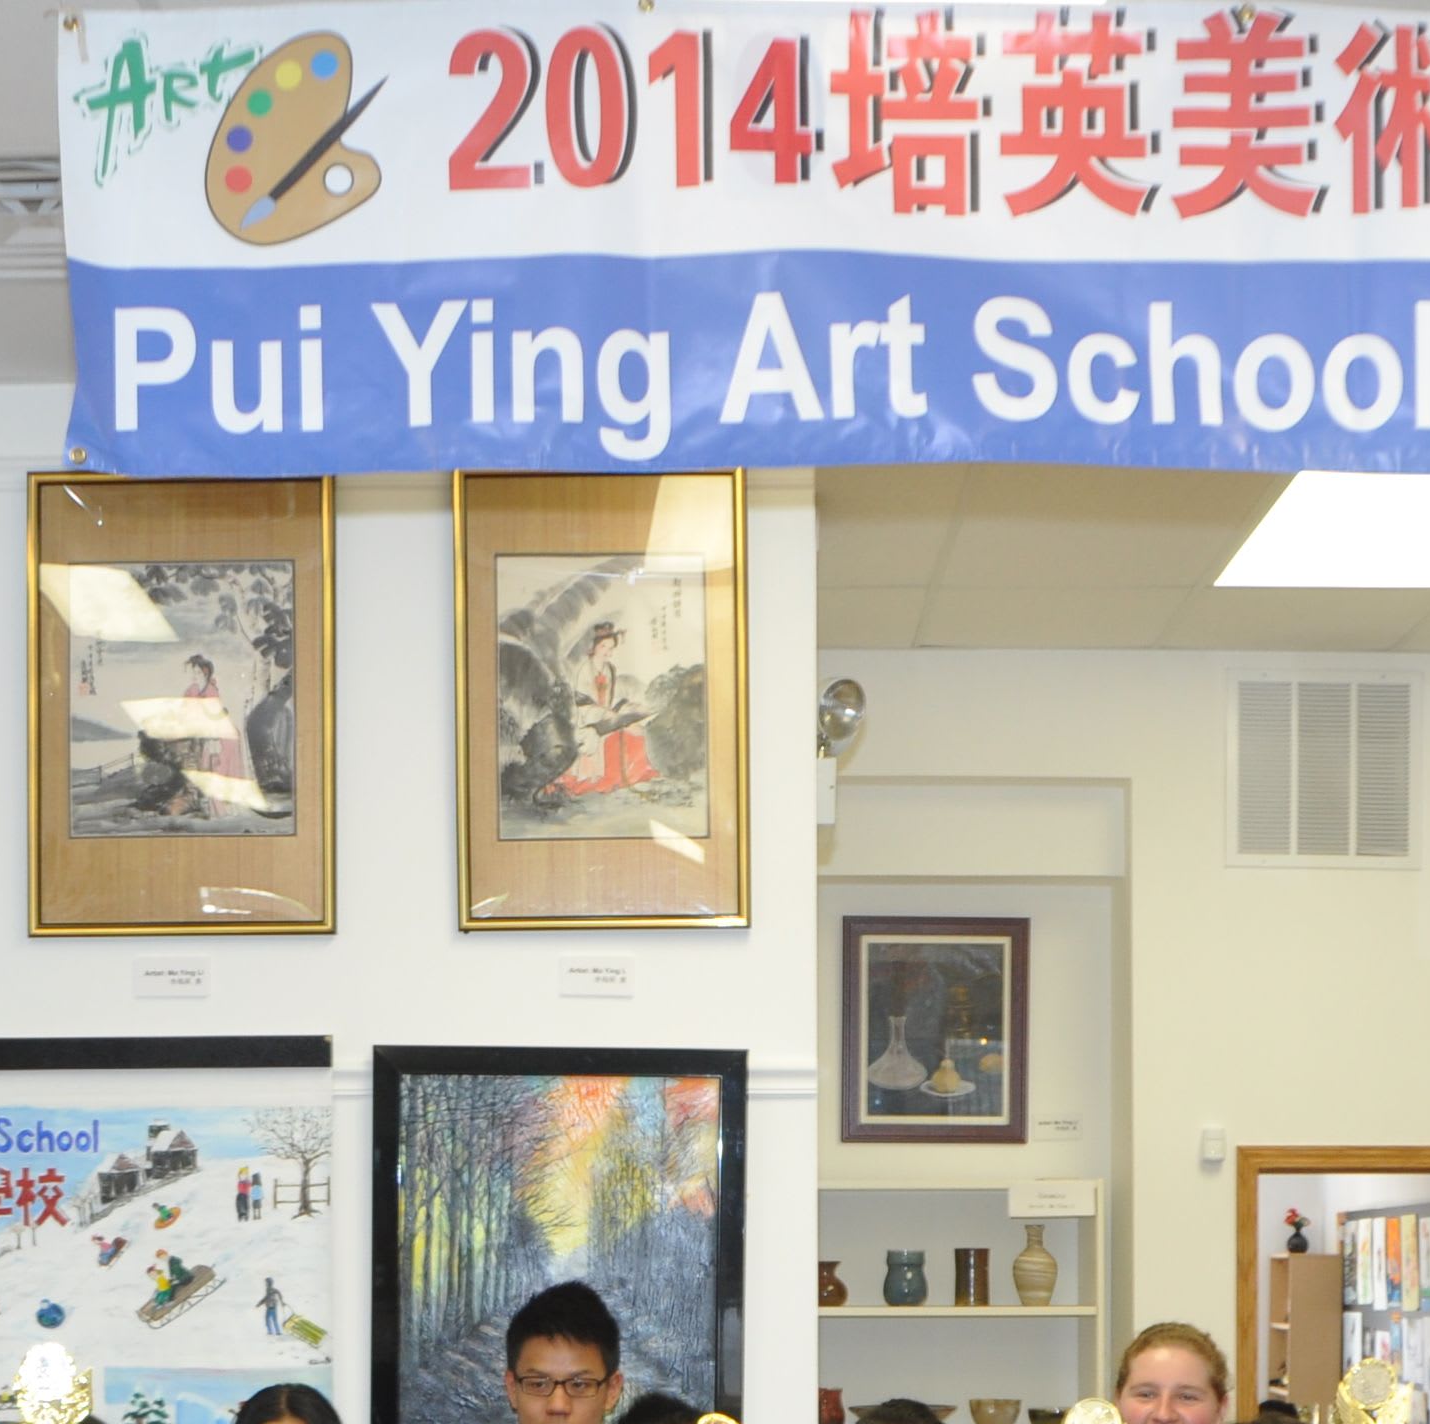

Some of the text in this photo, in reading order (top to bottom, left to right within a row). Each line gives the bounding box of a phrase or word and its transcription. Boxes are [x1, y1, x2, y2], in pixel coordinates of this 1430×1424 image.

[114, 303, 325, 433] Pui
[372, 297, 670, 462] Ying
[719, 291, 928, 425] Art
